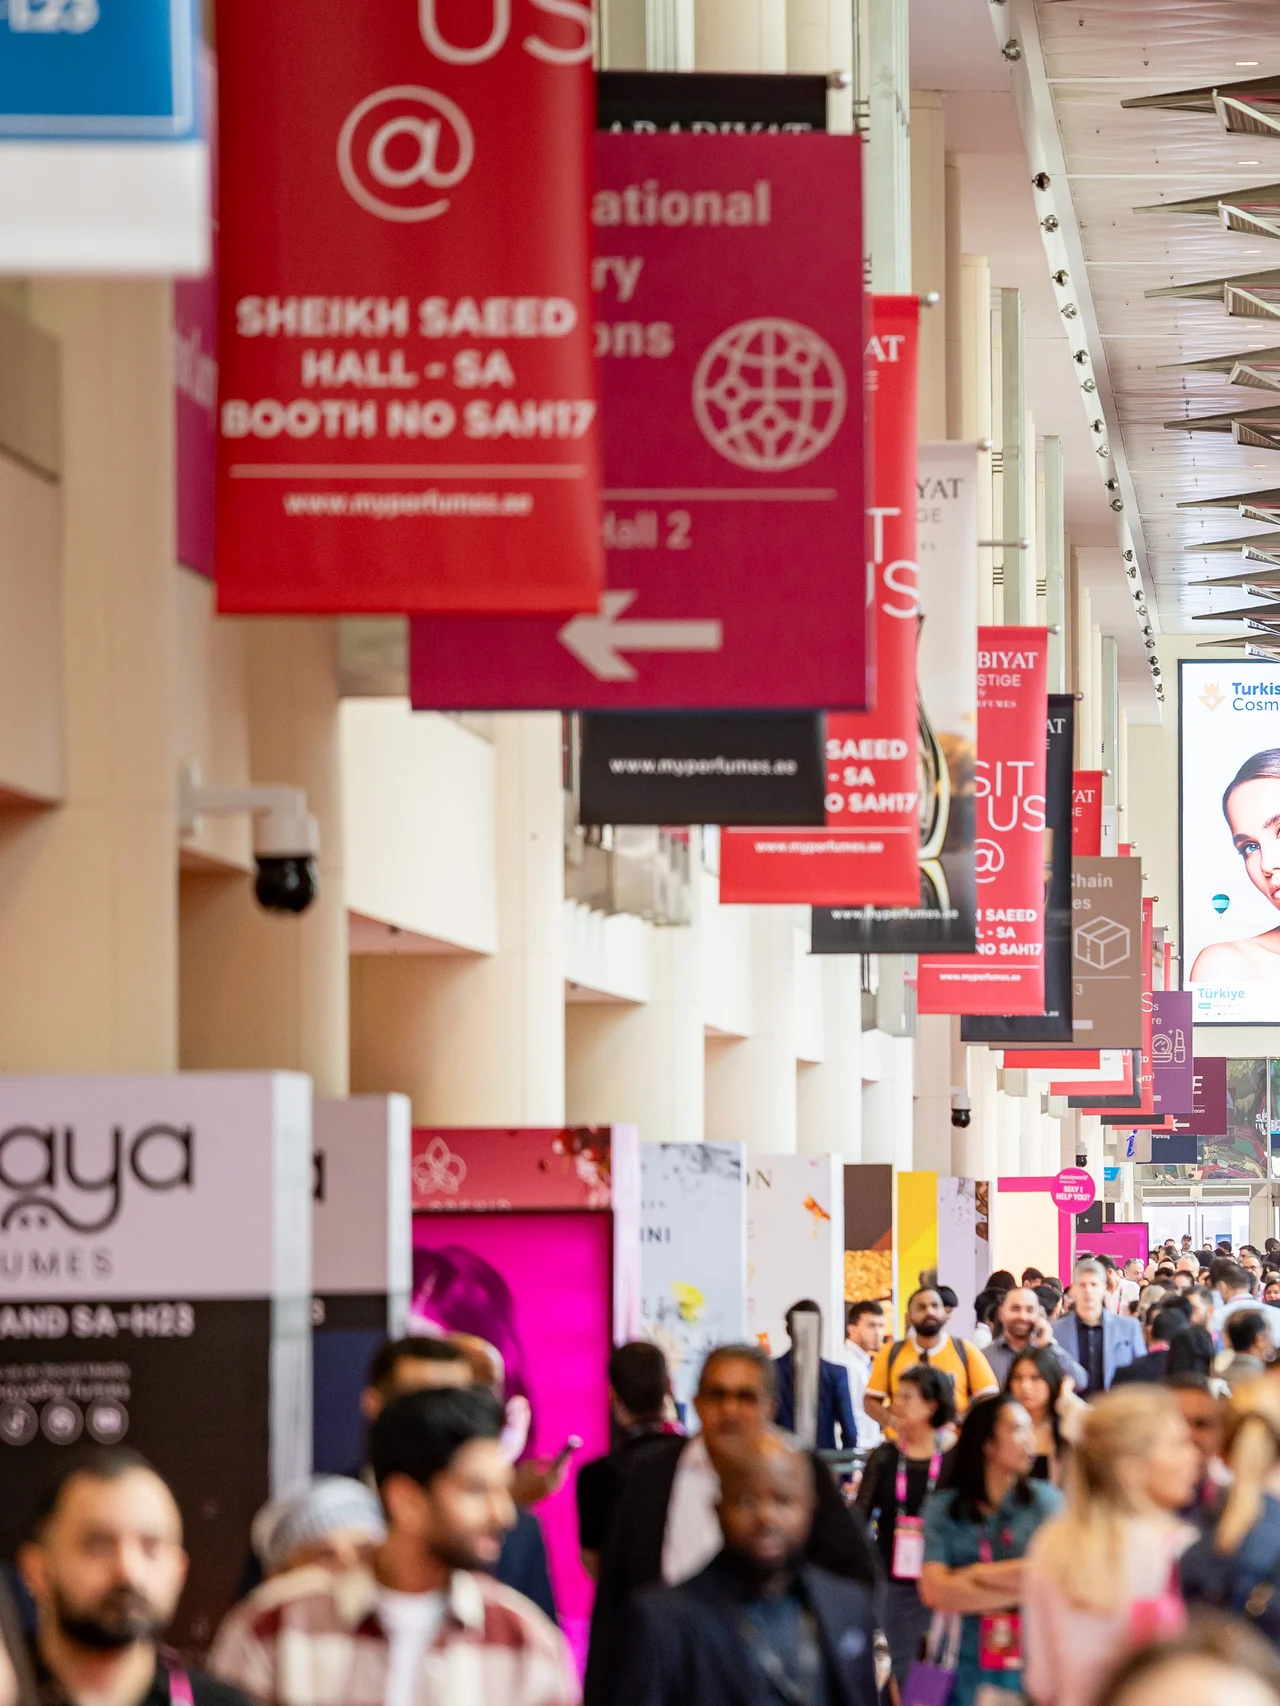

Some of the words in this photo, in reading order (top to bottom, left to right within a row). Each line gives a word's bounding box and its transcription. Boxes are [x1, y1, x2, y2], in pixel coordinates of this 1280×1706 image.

[337, 85, 474, 222] @
[235, 296, 409, 337] SHEIKH
[419, 296, 577, 337] SAEED
[301, 349, 419, 388] HALL
[453, 349, 515, 388] SA
[221, 400, 378, 438] BOOTH
[386, 400, 456, 438] NO
[463, 400, 596, 438] SAH17
[283, 489, 534, 520] www.myperfumes.ae
[665, 511, 693, 549] 2
[976, 651, 1038, 669] BIYAT
[825, 739, 908, 760] SAEED
[608, 756, 798, 777] www.myperfumes.ae
[843, 766, 875, 787] SA
[849, 792, 918, 813] SAH17
[988, 795, 1046, 832] US
[754, 840, 884, 855] www.myperfumes.ae
[985, 909, 1037, 922] SAEED
[996, 926, 1016, 939] SA
[999, 943, 1042, 956] SAH17
[939, 973, 1021, 982] www.myperfumes.ae
[1075, 984, 1083, 995] 3
[1197, 988, 1245, 1001] Türkiye
